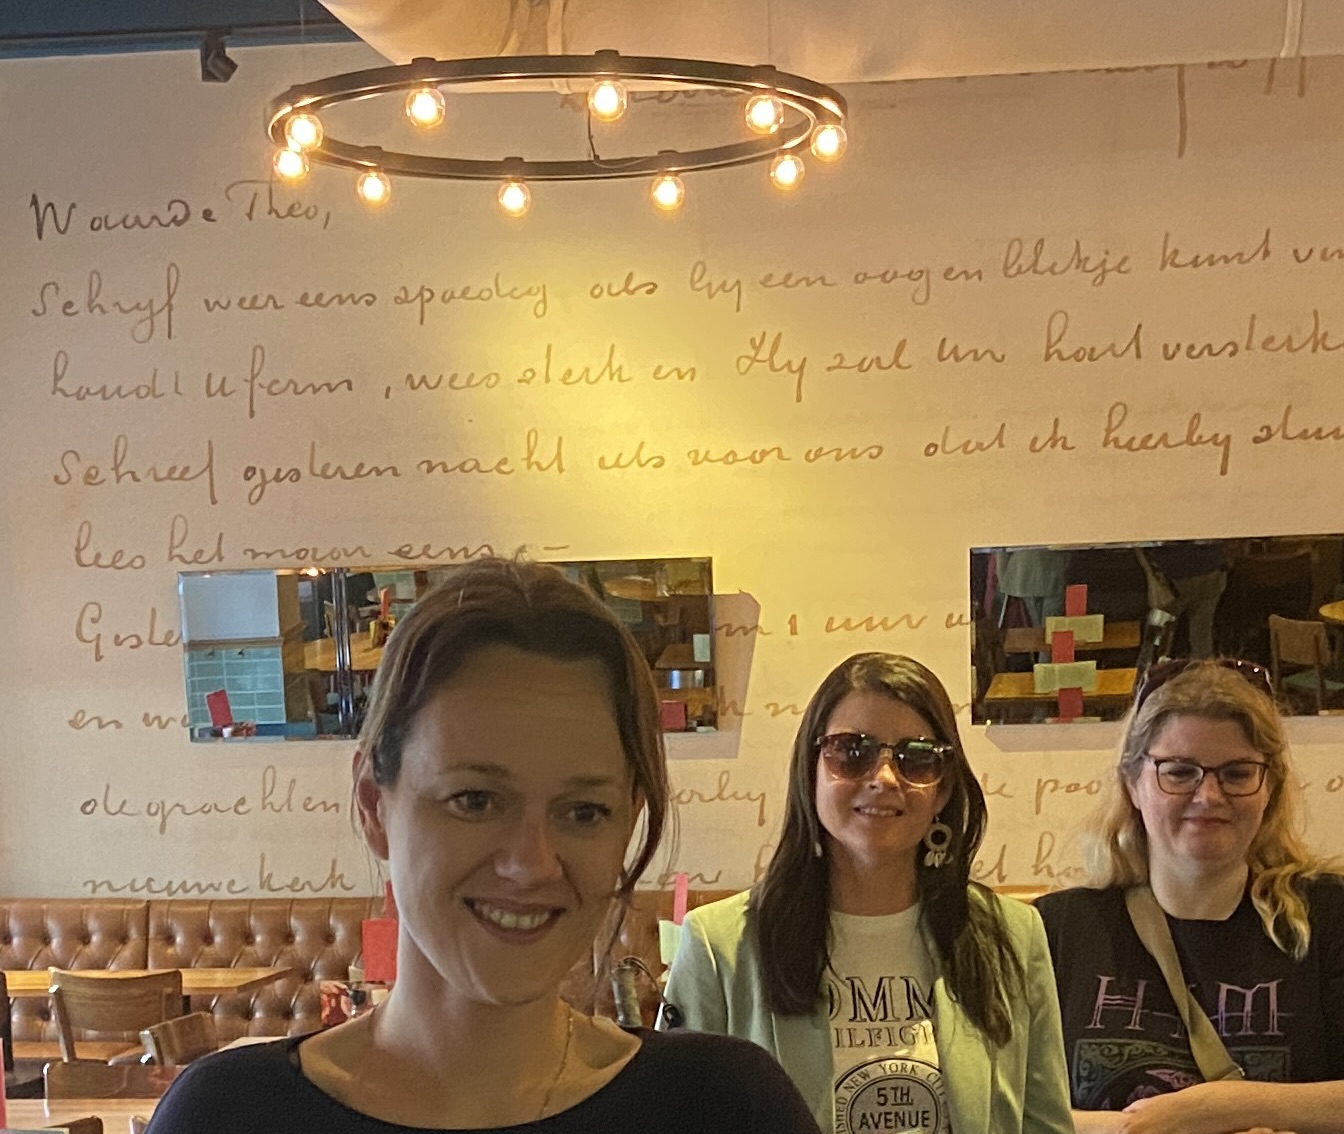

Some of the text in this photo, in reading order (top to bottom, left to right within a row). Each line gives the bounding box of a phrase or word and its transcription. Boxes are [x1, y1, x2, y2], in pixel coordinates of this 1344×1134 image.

[1158, 227, 1272, 272] kunt
[652, 363, 697, 383] en
[803, 442, 885, 464] ons
[923, 422, 1006, 457] dat
[168, 514, 226, 566] het
[878, 1063, 920, 1075] YORK
[859, 1110, 930, 1130] AVENUE
